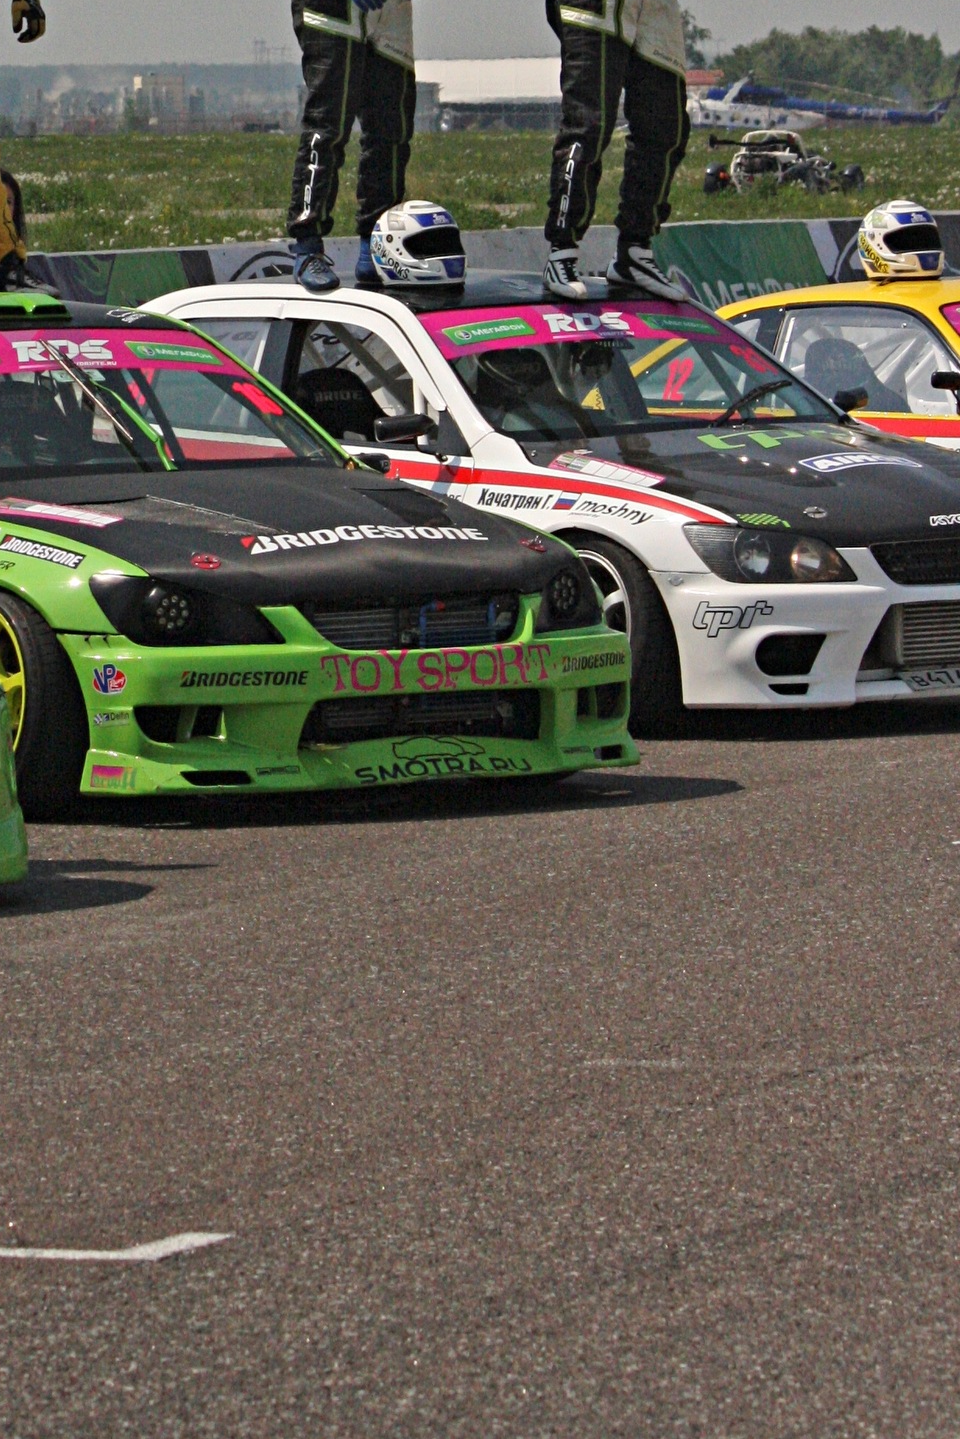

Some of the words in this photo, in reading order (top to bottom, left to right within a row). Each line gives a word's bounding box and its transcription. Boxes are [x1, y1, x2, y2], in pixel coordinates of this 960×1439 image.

[542, 311, 630, 333] RDS
[11, 339, 114, 363] RDS
[662, 357, 695, 402] 12
[477, 488, 541, 510] Хачатрян
[541, 493, 554, 510] Г.
[574, 497, 654, 525] moshny
[241, 524, 489, 555] BRIDGESTONE
[561, 651, 626, 673] BRIDGESTONE
[179, 671, 309, 688] BRIDGESTONE
[355, 756, 533, 785] SMOTRA.RU
